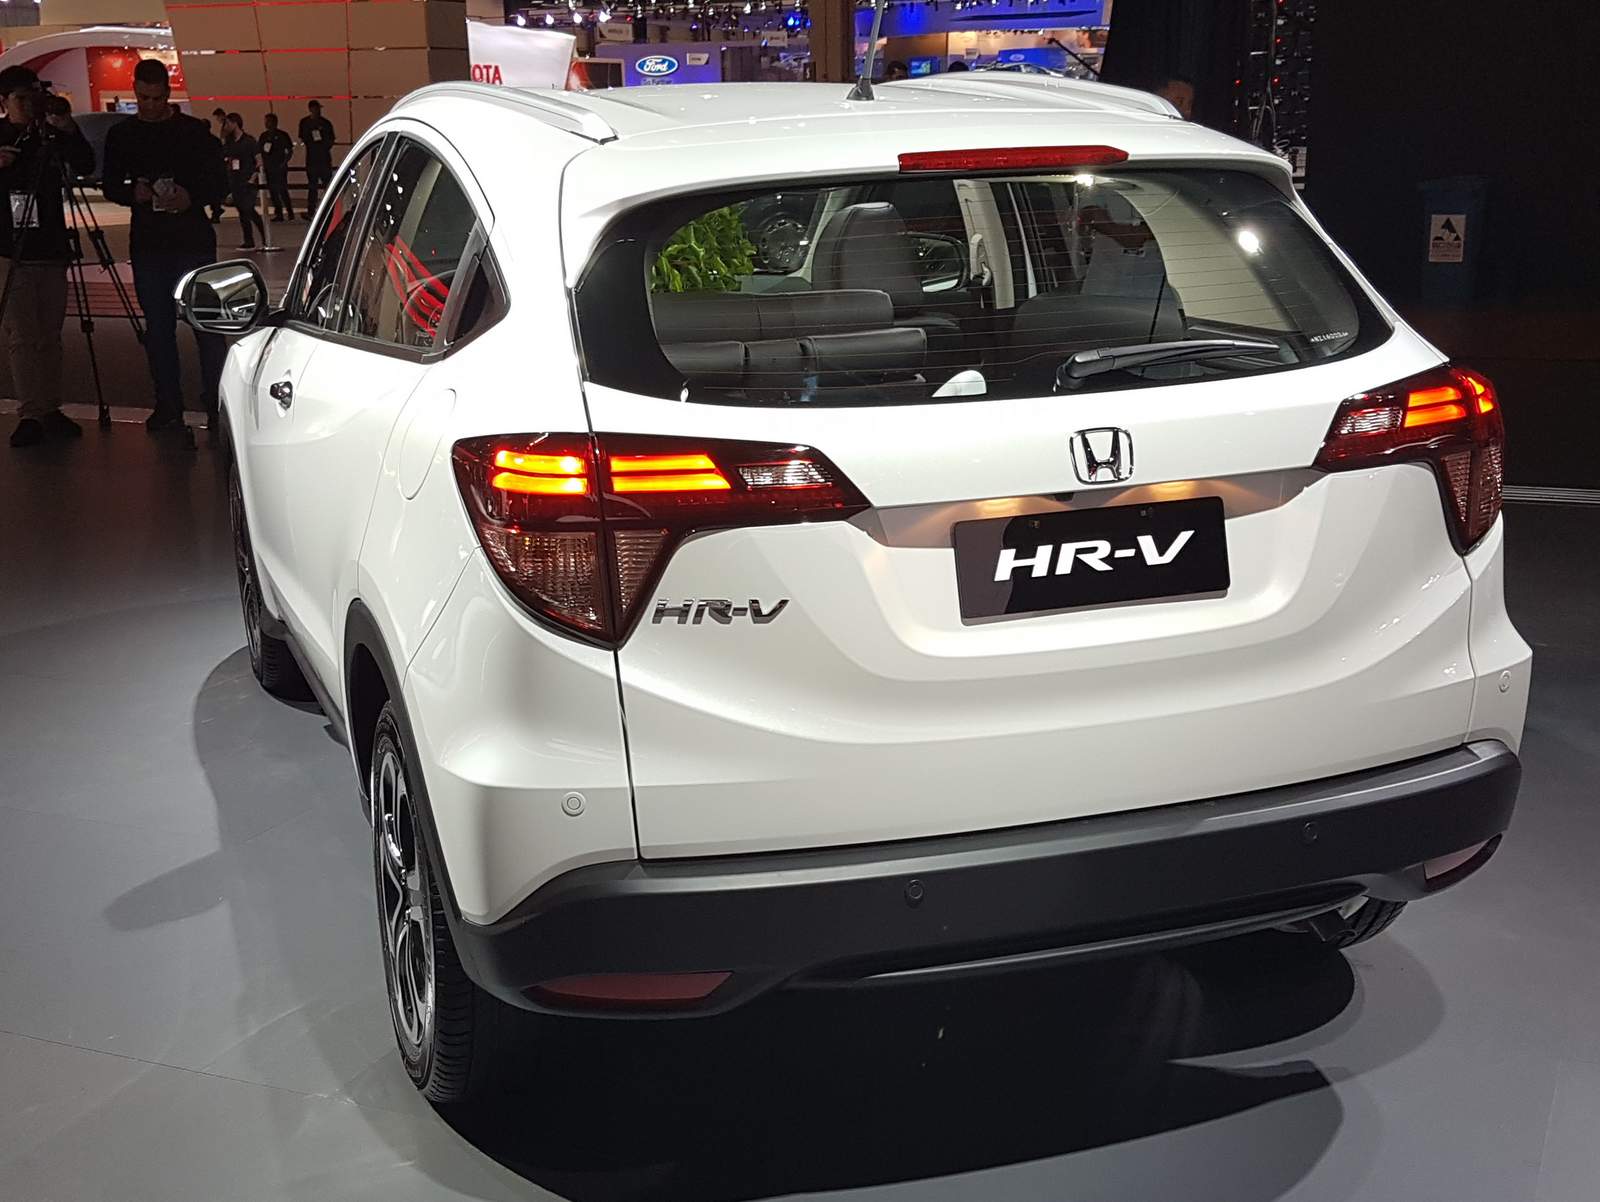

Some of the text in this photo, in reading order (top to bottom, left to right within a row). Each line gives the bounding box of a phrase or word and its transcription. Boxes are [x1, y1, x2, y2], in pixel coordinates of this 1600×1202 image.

[641, 58, 671, 73] Ford
[994, 529, 1195, 582] HR-V
[652, 599, 790, 625] HR-V
